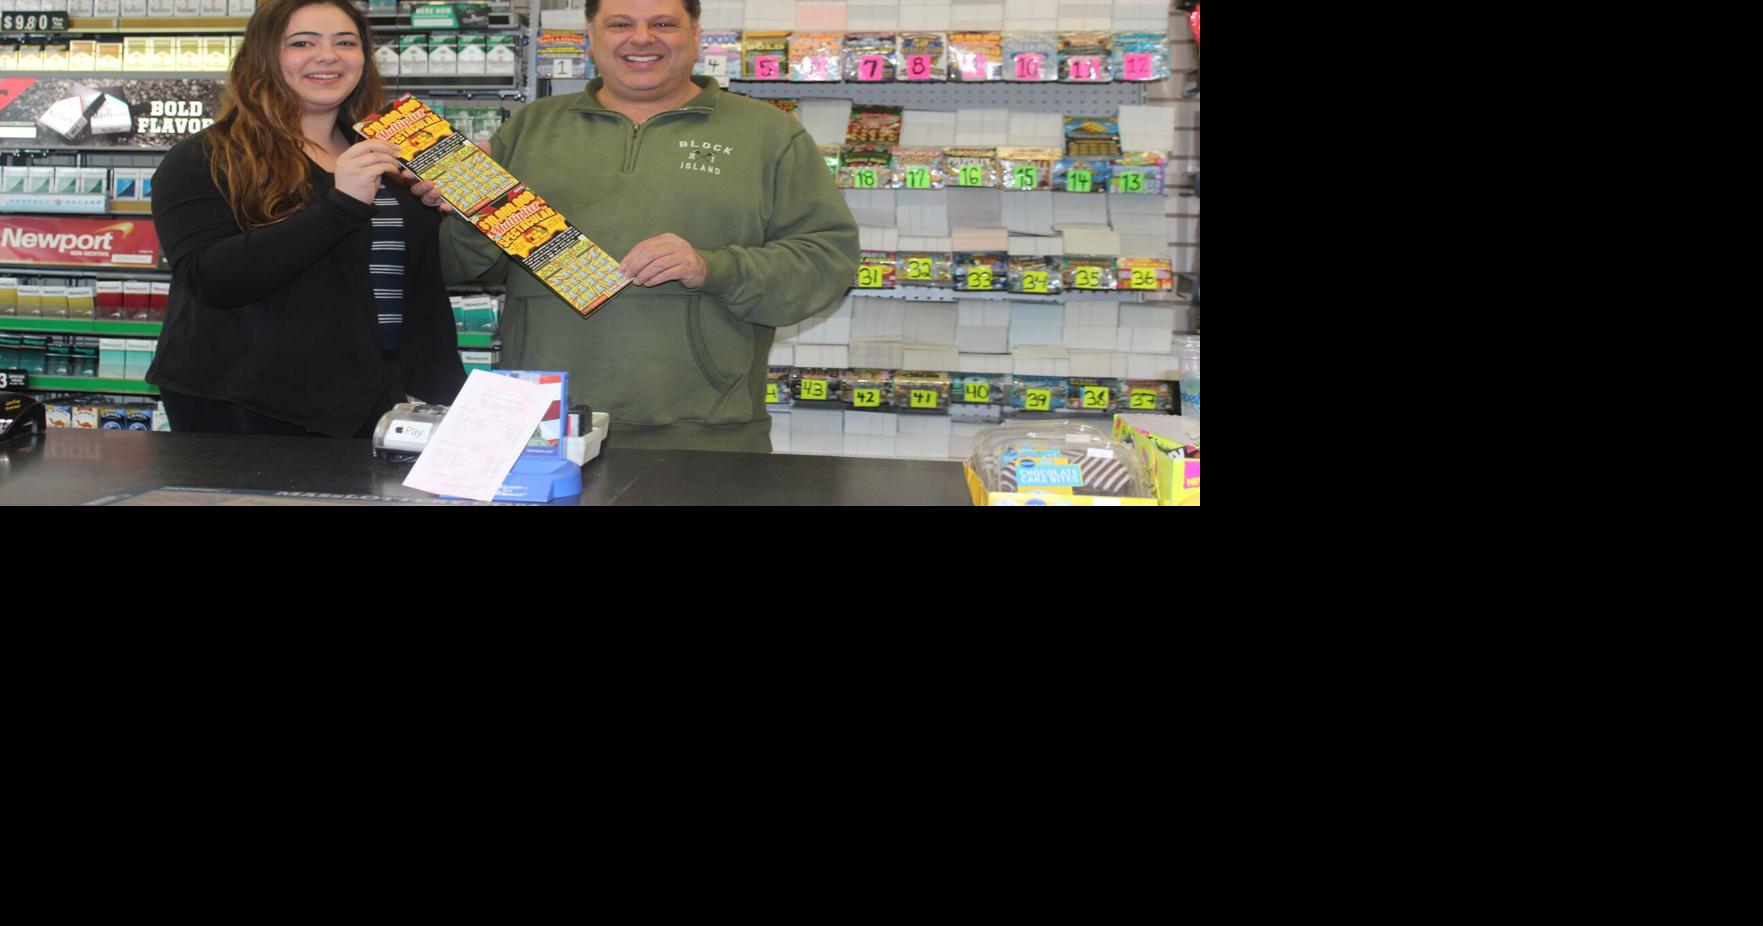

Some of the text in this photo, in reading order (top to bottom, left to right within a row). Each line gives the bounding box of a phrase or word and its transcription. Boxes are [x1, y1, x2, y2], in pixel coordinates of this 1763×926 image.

[557, 61, 568, 75] 1
[708, 59, 719, 72] 4
[759, 60, 773, 76] 5
[863, 59, 878, 77] 7
[912, 57, 925, 75] 8
[1128, 58, 1148, 74] 12
[150, 100, 203, 117] BOLD
[376, 108, 425, 140] Multiplier
[679, 140, 733, 155] BLOCK
[680, 161, 721, 175] ISLAND
[961, 167, 979, 185] 16
[856, 171, 874, 186] 18
[908, 169, 925, 186] 17
[1016, 168, 1034, 186] 15
[1070, 172, 1089, 189] 14
[1122, 174, 1141, 191] 13
[491, 202, 541, 235] Multiplier
[497, 207, 555, 248] SPECTACULAR
[1, 227, 114, 253] Newport
[860, 268, 877, 286] 31
[909, 261, 931, 278] 32
[968, 272, 991, 288] 33
[1023, 274, 1047, 290] 34
[1076, 270, 1100, 287] 35
[1132, 270, 1155, 286] 36
[803, 381, 824, 397] 43
[966, 384, 989, 400] 40
[857, 392, 874, 403] 42
[913, 392, 931, 403] 41
[1027, 393, 1047, 407] 39
[1131, 391, 1156, 406] 37
[405, 425, 424, 438] Pay
[1019, 468, 1078, 478] CHOCOLATE
